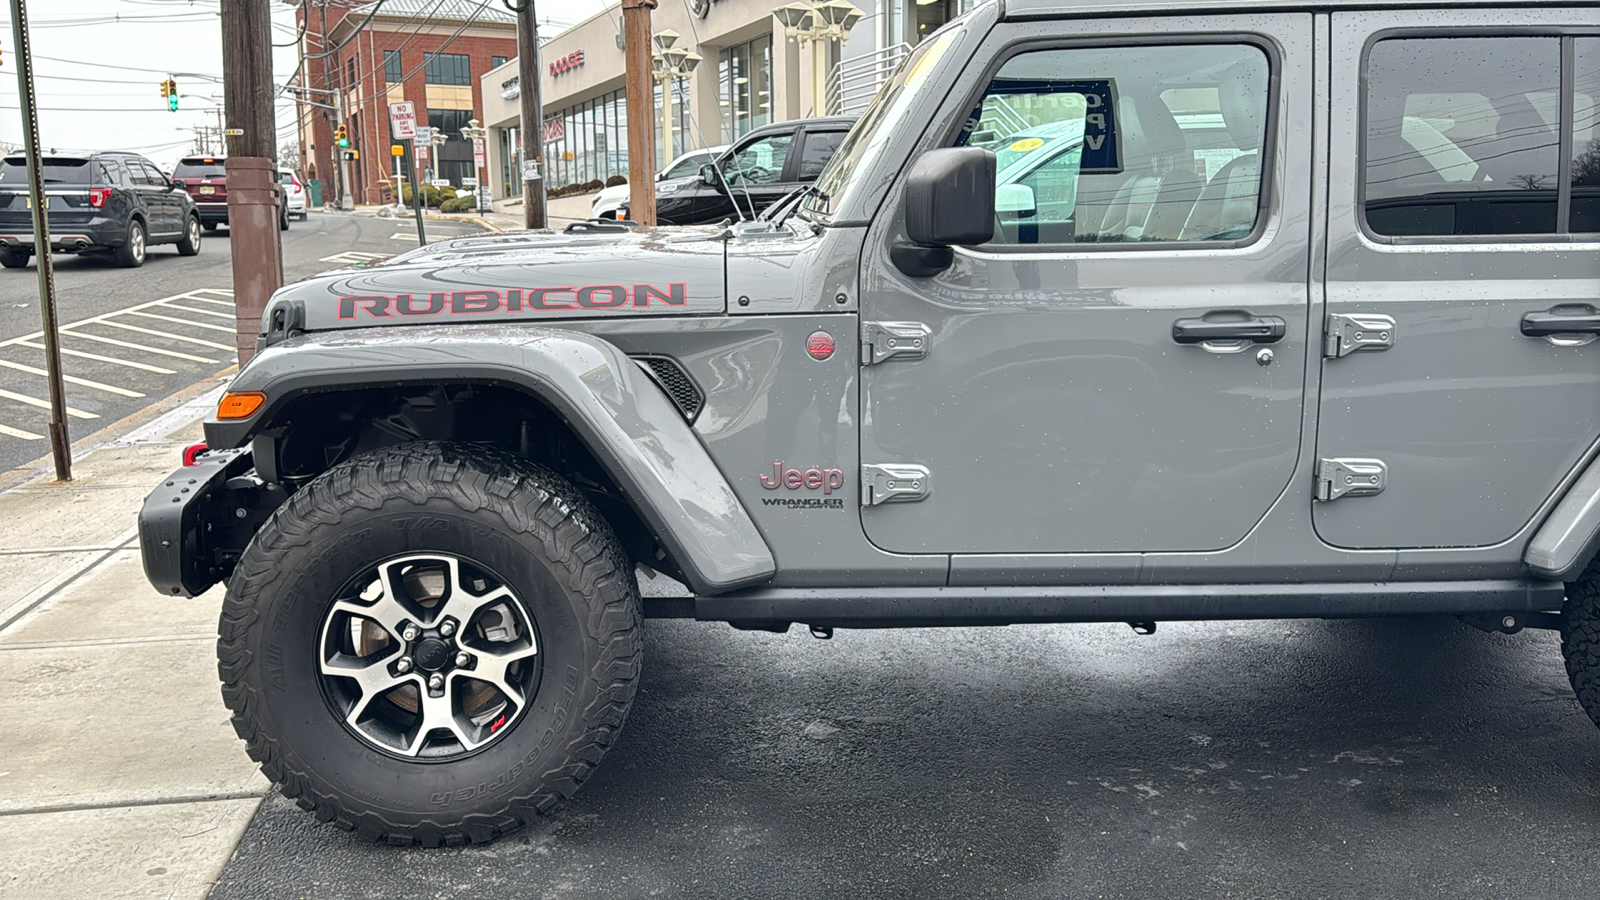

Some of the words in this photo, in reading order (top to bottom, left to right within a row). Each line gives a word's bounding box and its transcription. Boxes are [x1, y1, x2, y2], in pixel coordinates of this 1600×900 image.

[549, 50, 584, 77] DODGE
[337, 282, 687, 320] RUBICON
[760, 461, 844, 495] Jeep
[761, 498, 844, 506] WRANGLER
[430, 664, 580, 807] BFGoodrich
